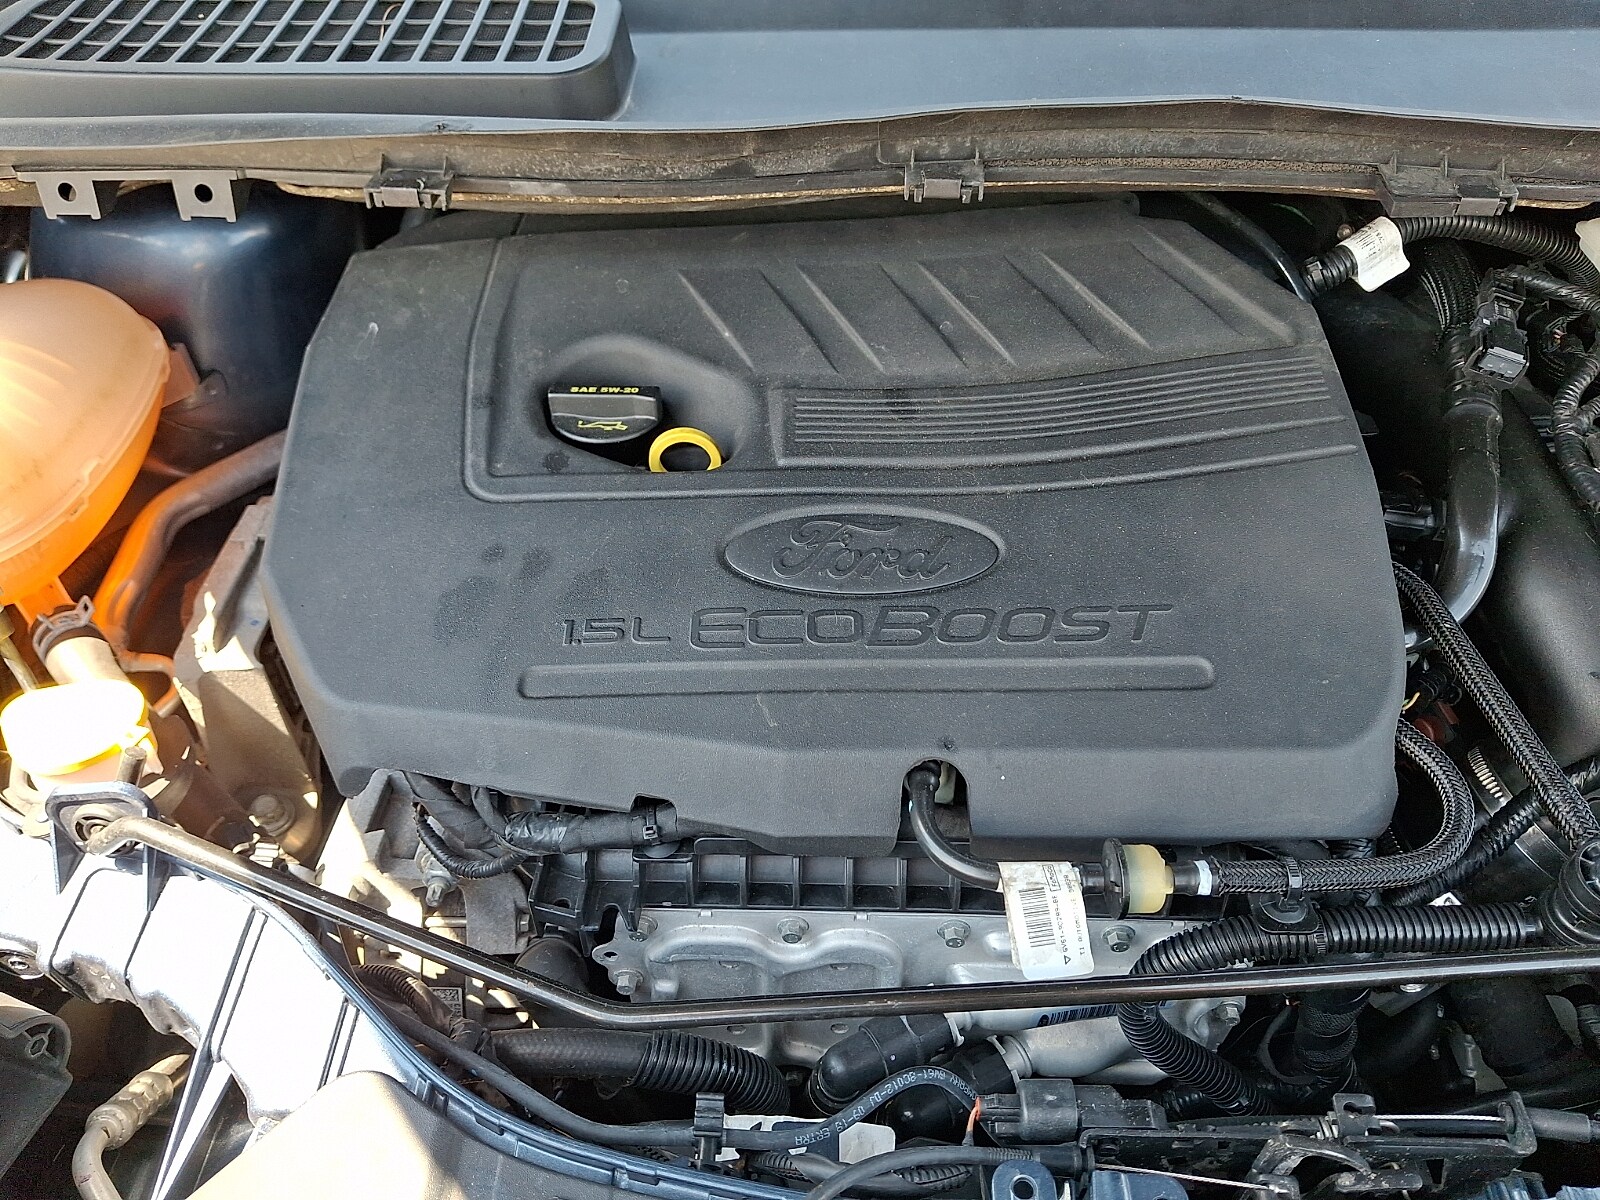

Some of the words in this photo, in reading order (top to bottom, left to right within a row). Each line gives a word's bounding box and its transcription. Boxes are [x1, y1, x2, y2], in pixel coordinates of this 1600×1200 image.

[600, 386, 640, 394] 5W-20
[771, 519, 952, 580] Ford
[562, 616, 671, 646] 1.5L
